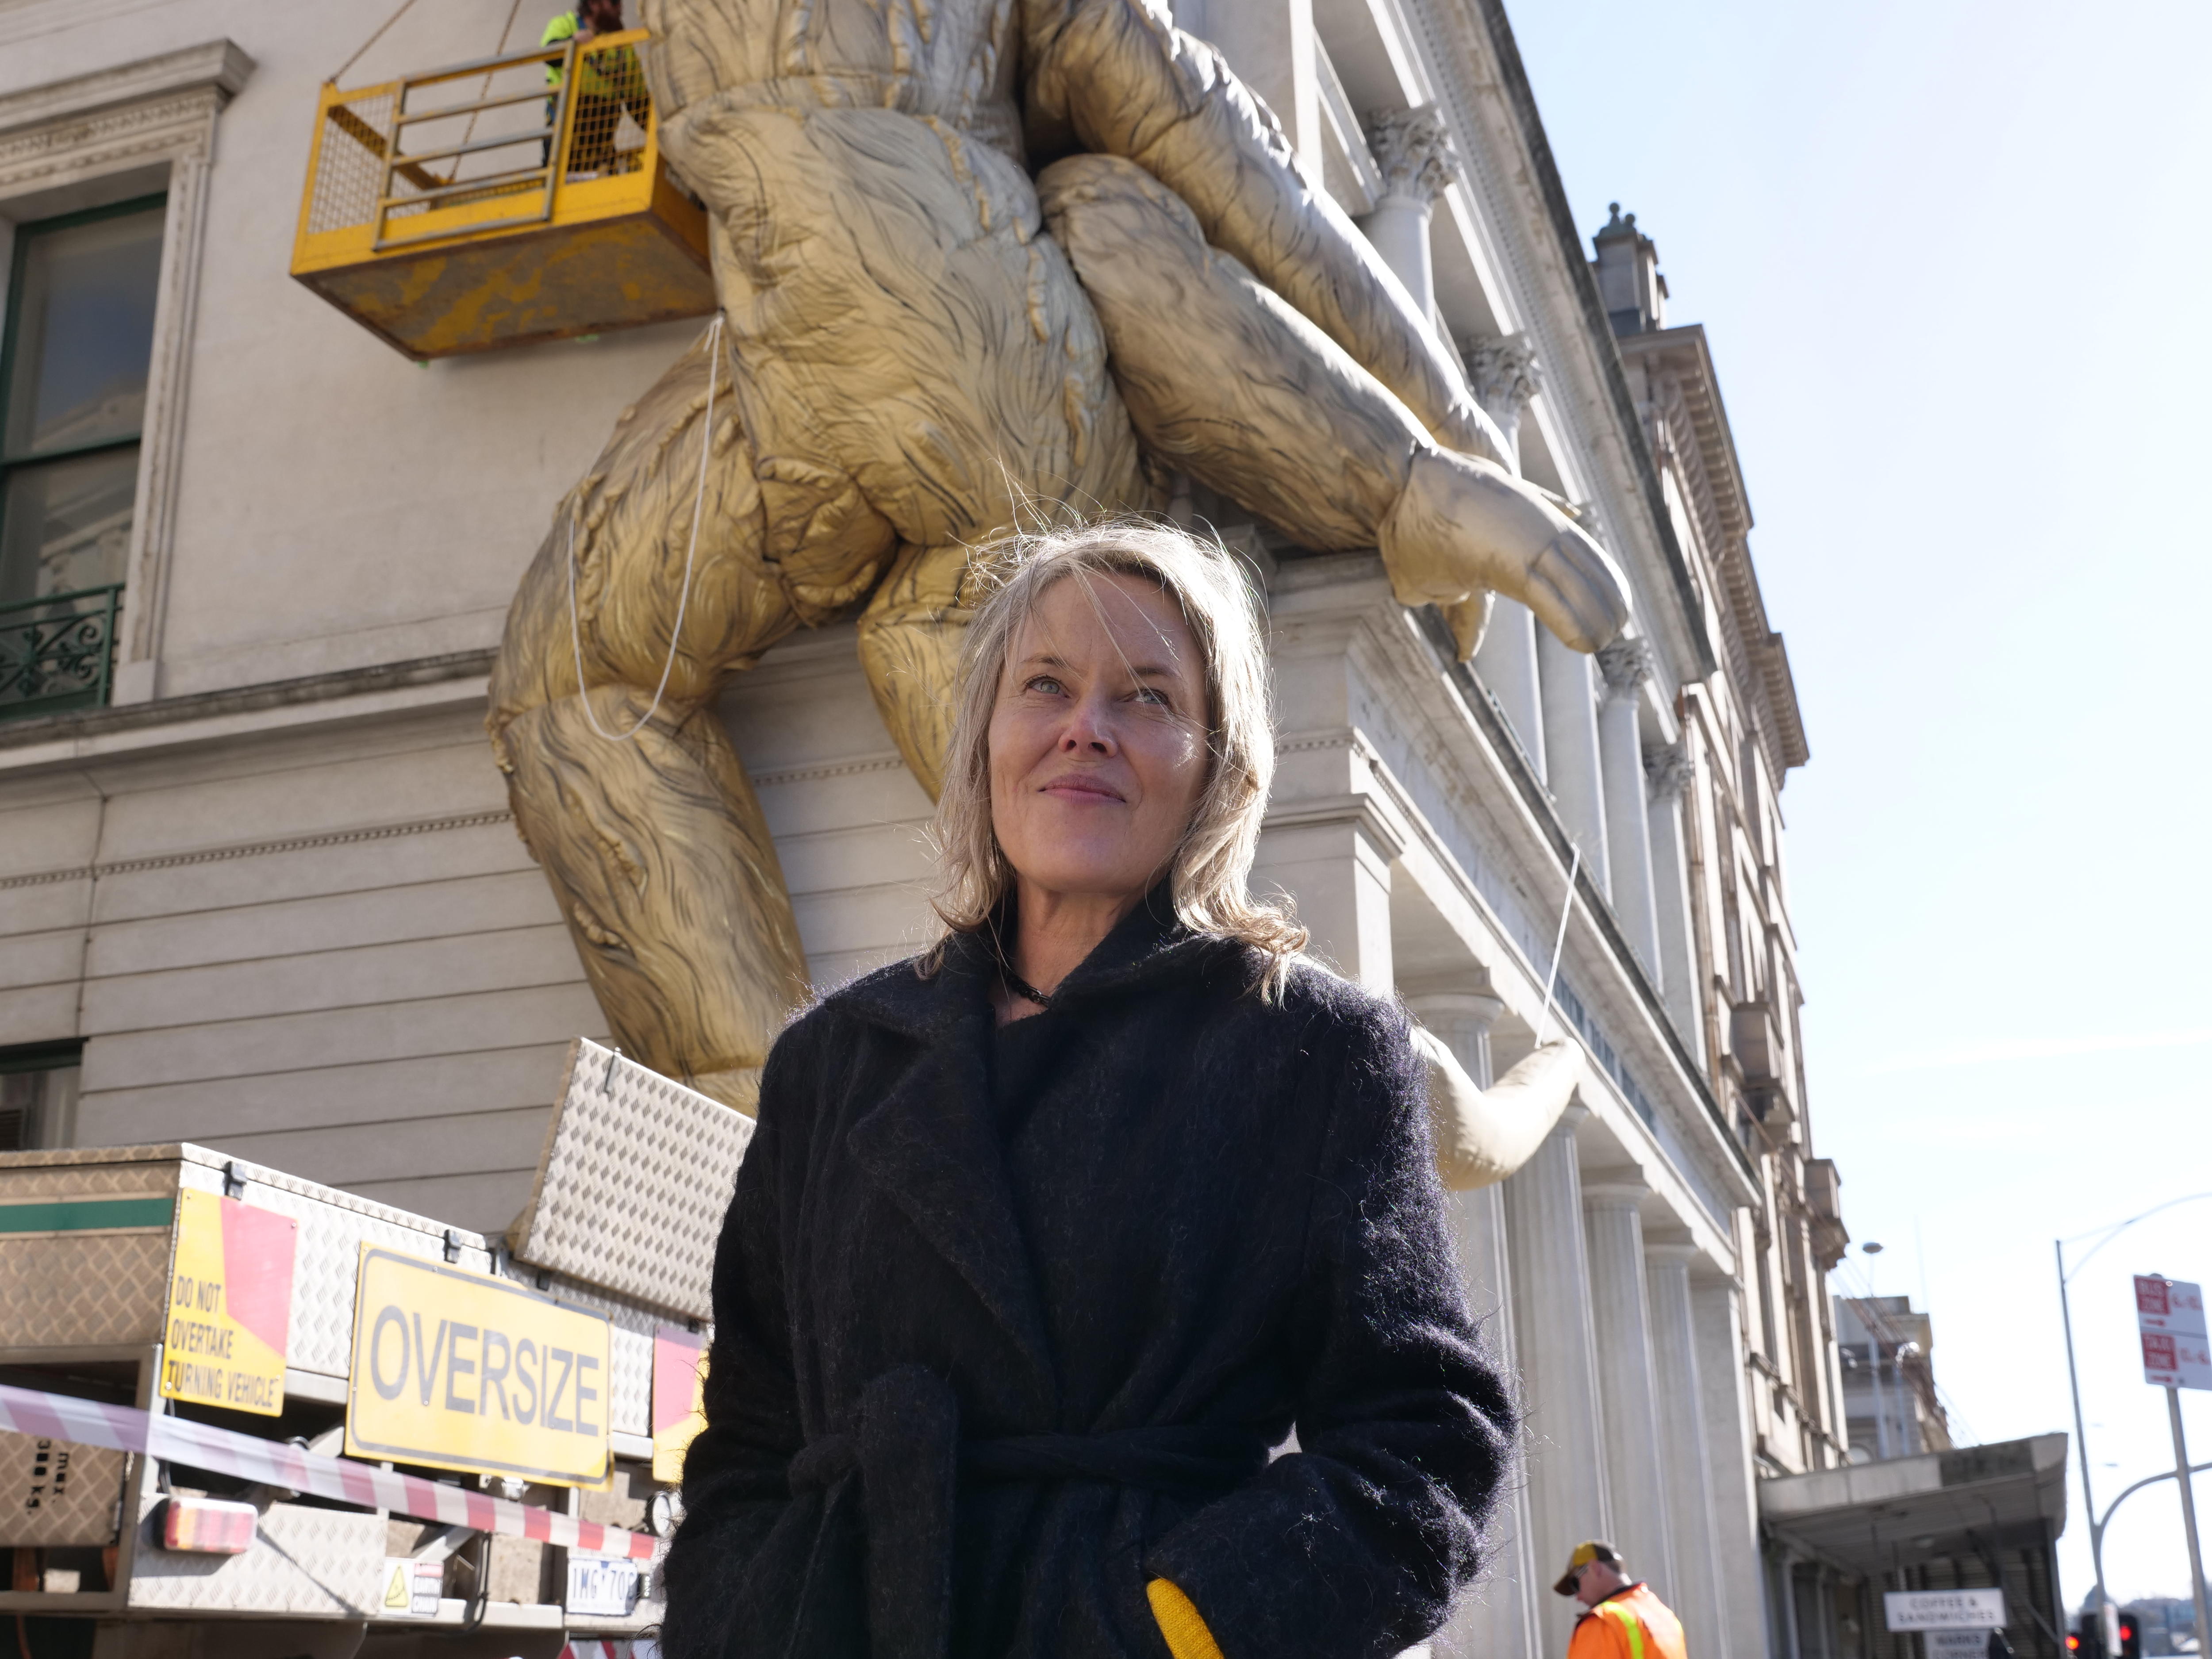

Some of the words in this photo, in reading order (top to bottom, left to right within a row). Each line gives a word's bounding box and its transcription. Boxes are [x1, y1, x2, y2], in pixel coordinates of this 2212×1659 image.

[176, 1275, 193, 1308] DO
[197, 1280, 221, 1314] NOT
[172, 1318, 234, 1359] OVERTAKE
[169, 1360, 223, 1399] TURNING
[227, 1371, 274, 1408] VEHICLE
[371, 1305, 599, 1437] OVERSIZE
[1909, 1597, 1963, 1610] COFFEE
